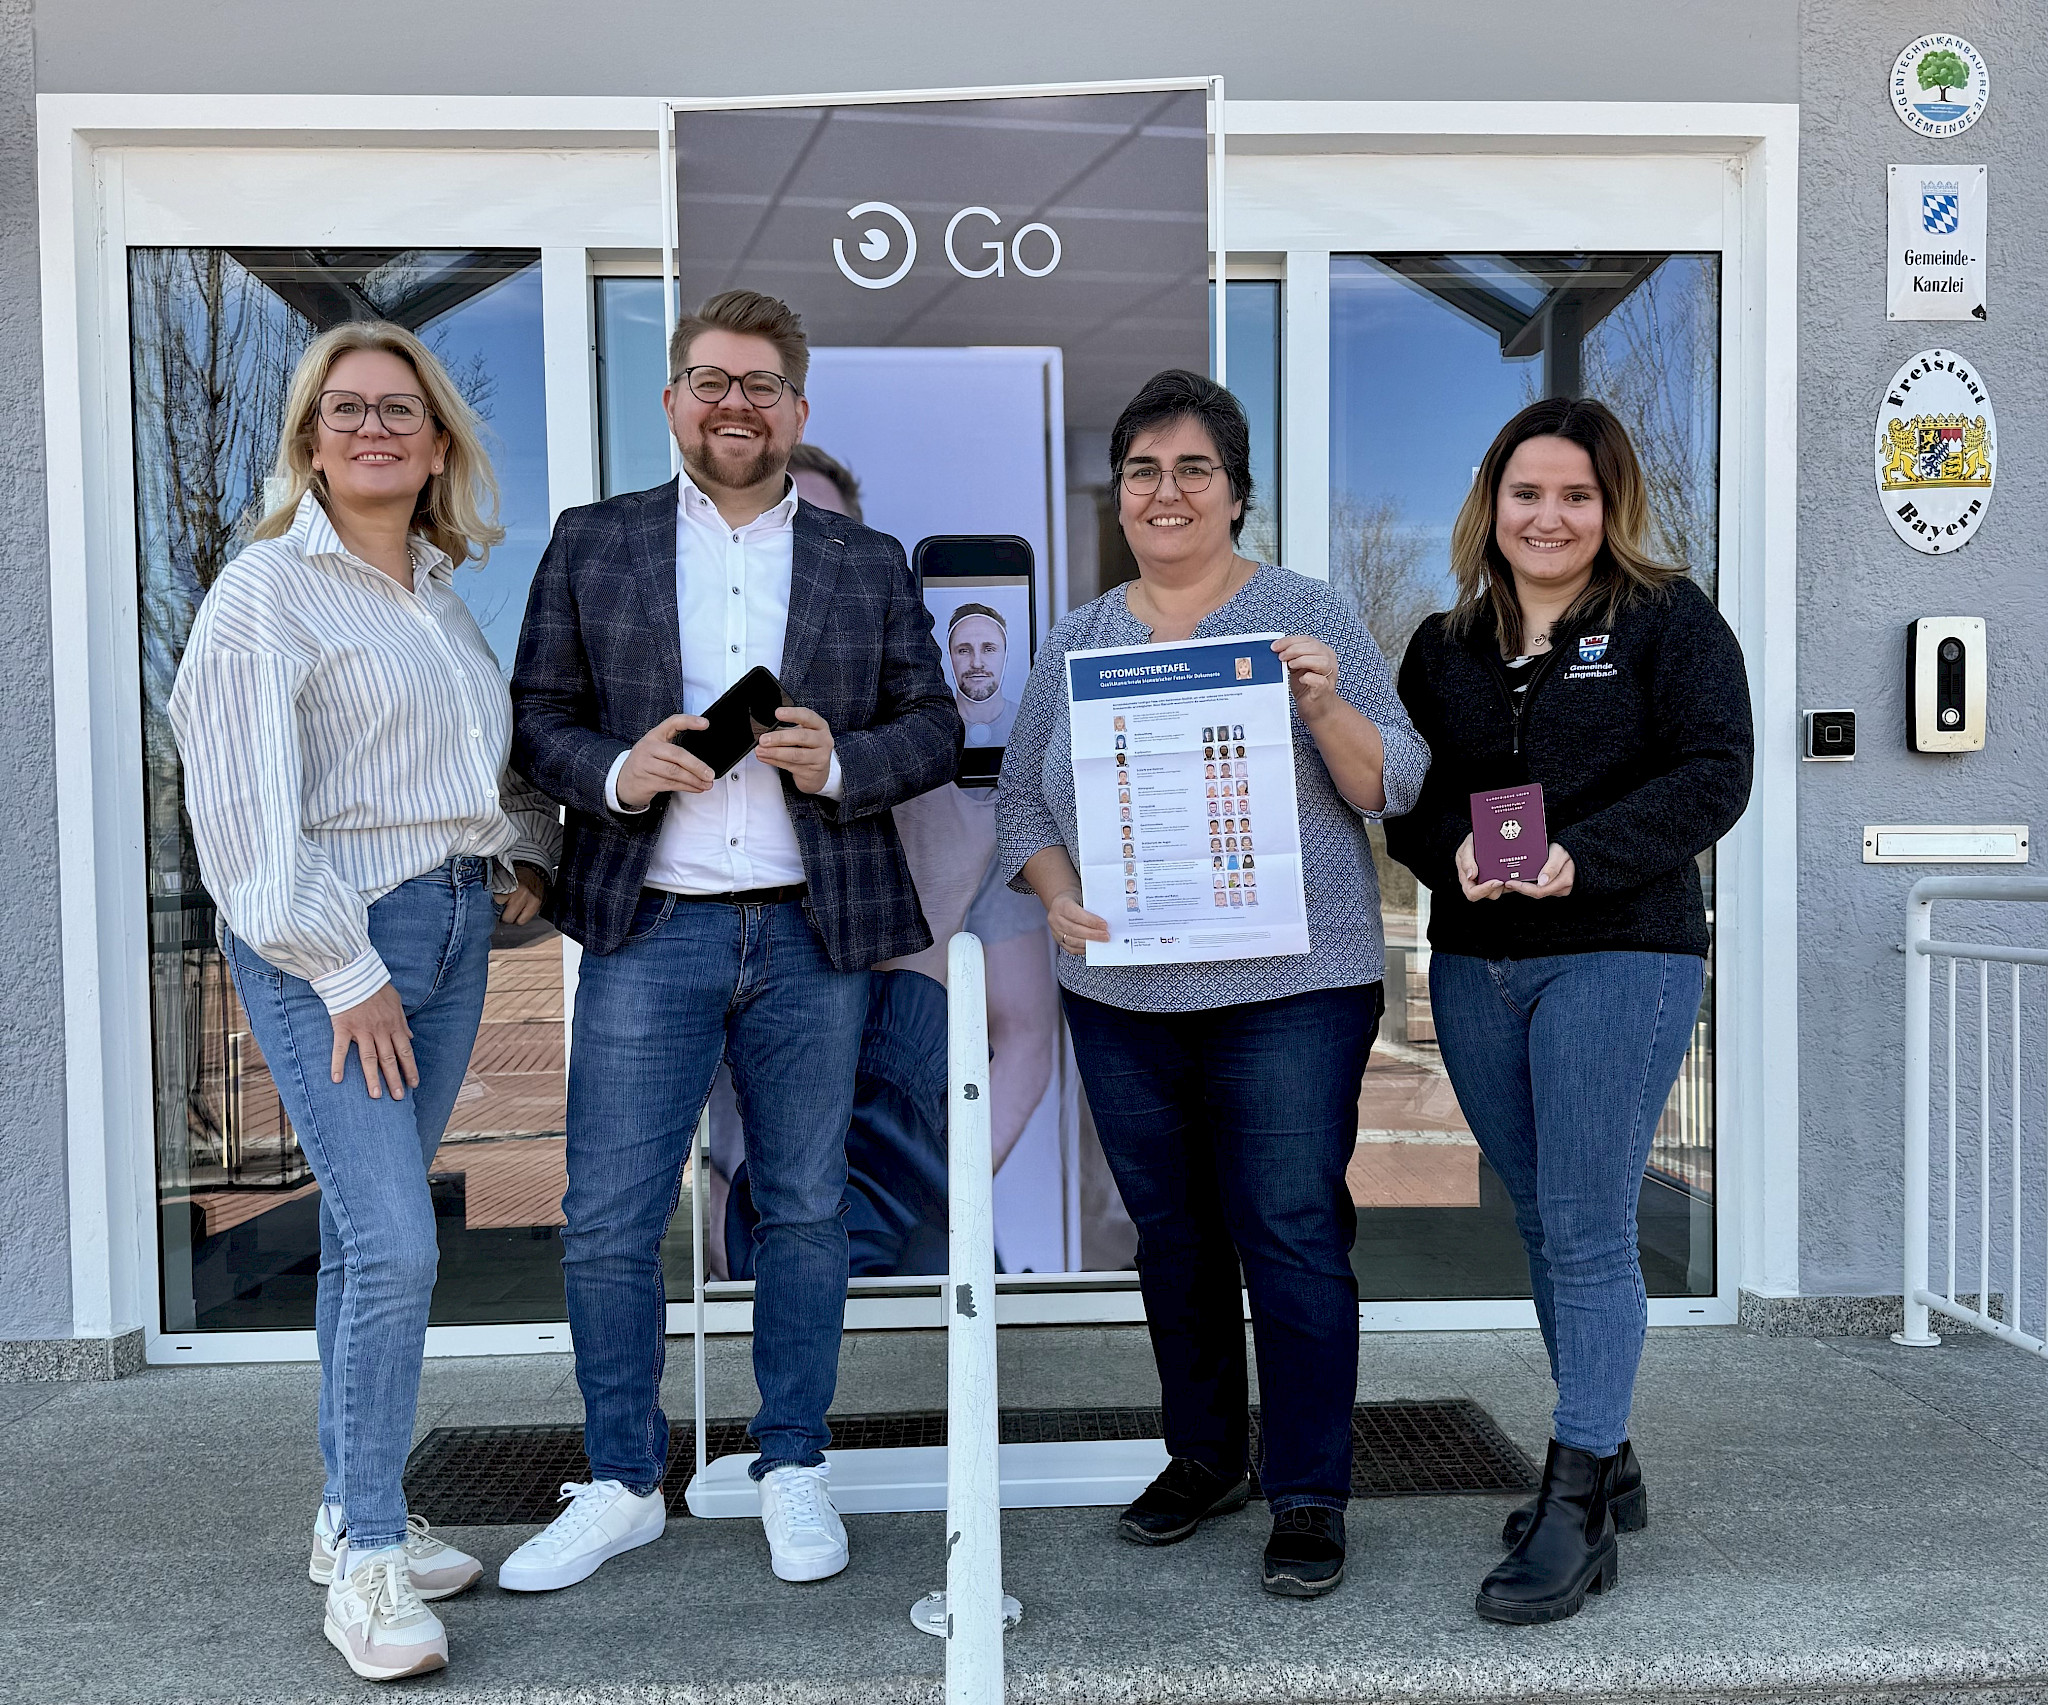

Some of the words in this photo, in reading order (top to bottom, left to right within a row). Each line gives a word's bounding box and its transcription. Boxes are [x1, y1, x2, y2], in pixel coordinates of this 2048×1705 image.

[1907, 112, 1973, 134] GEMEINDE
[944, 206, 1062, 279] Go
[1904, 249, 1976, 266] Gemeinde-
[1913, 276, 1964, 293] Kanzlei
[1886, 358, 1986, 409] Freistaat
[1896, 499, 1982, 542] Bayern
[1099, 662, 1190, 680] FOTOMUSTERTAFEL
[1563, 669, 1618, 680] Langenbach
[1569, 662, 1614, 672] Gemeinde
